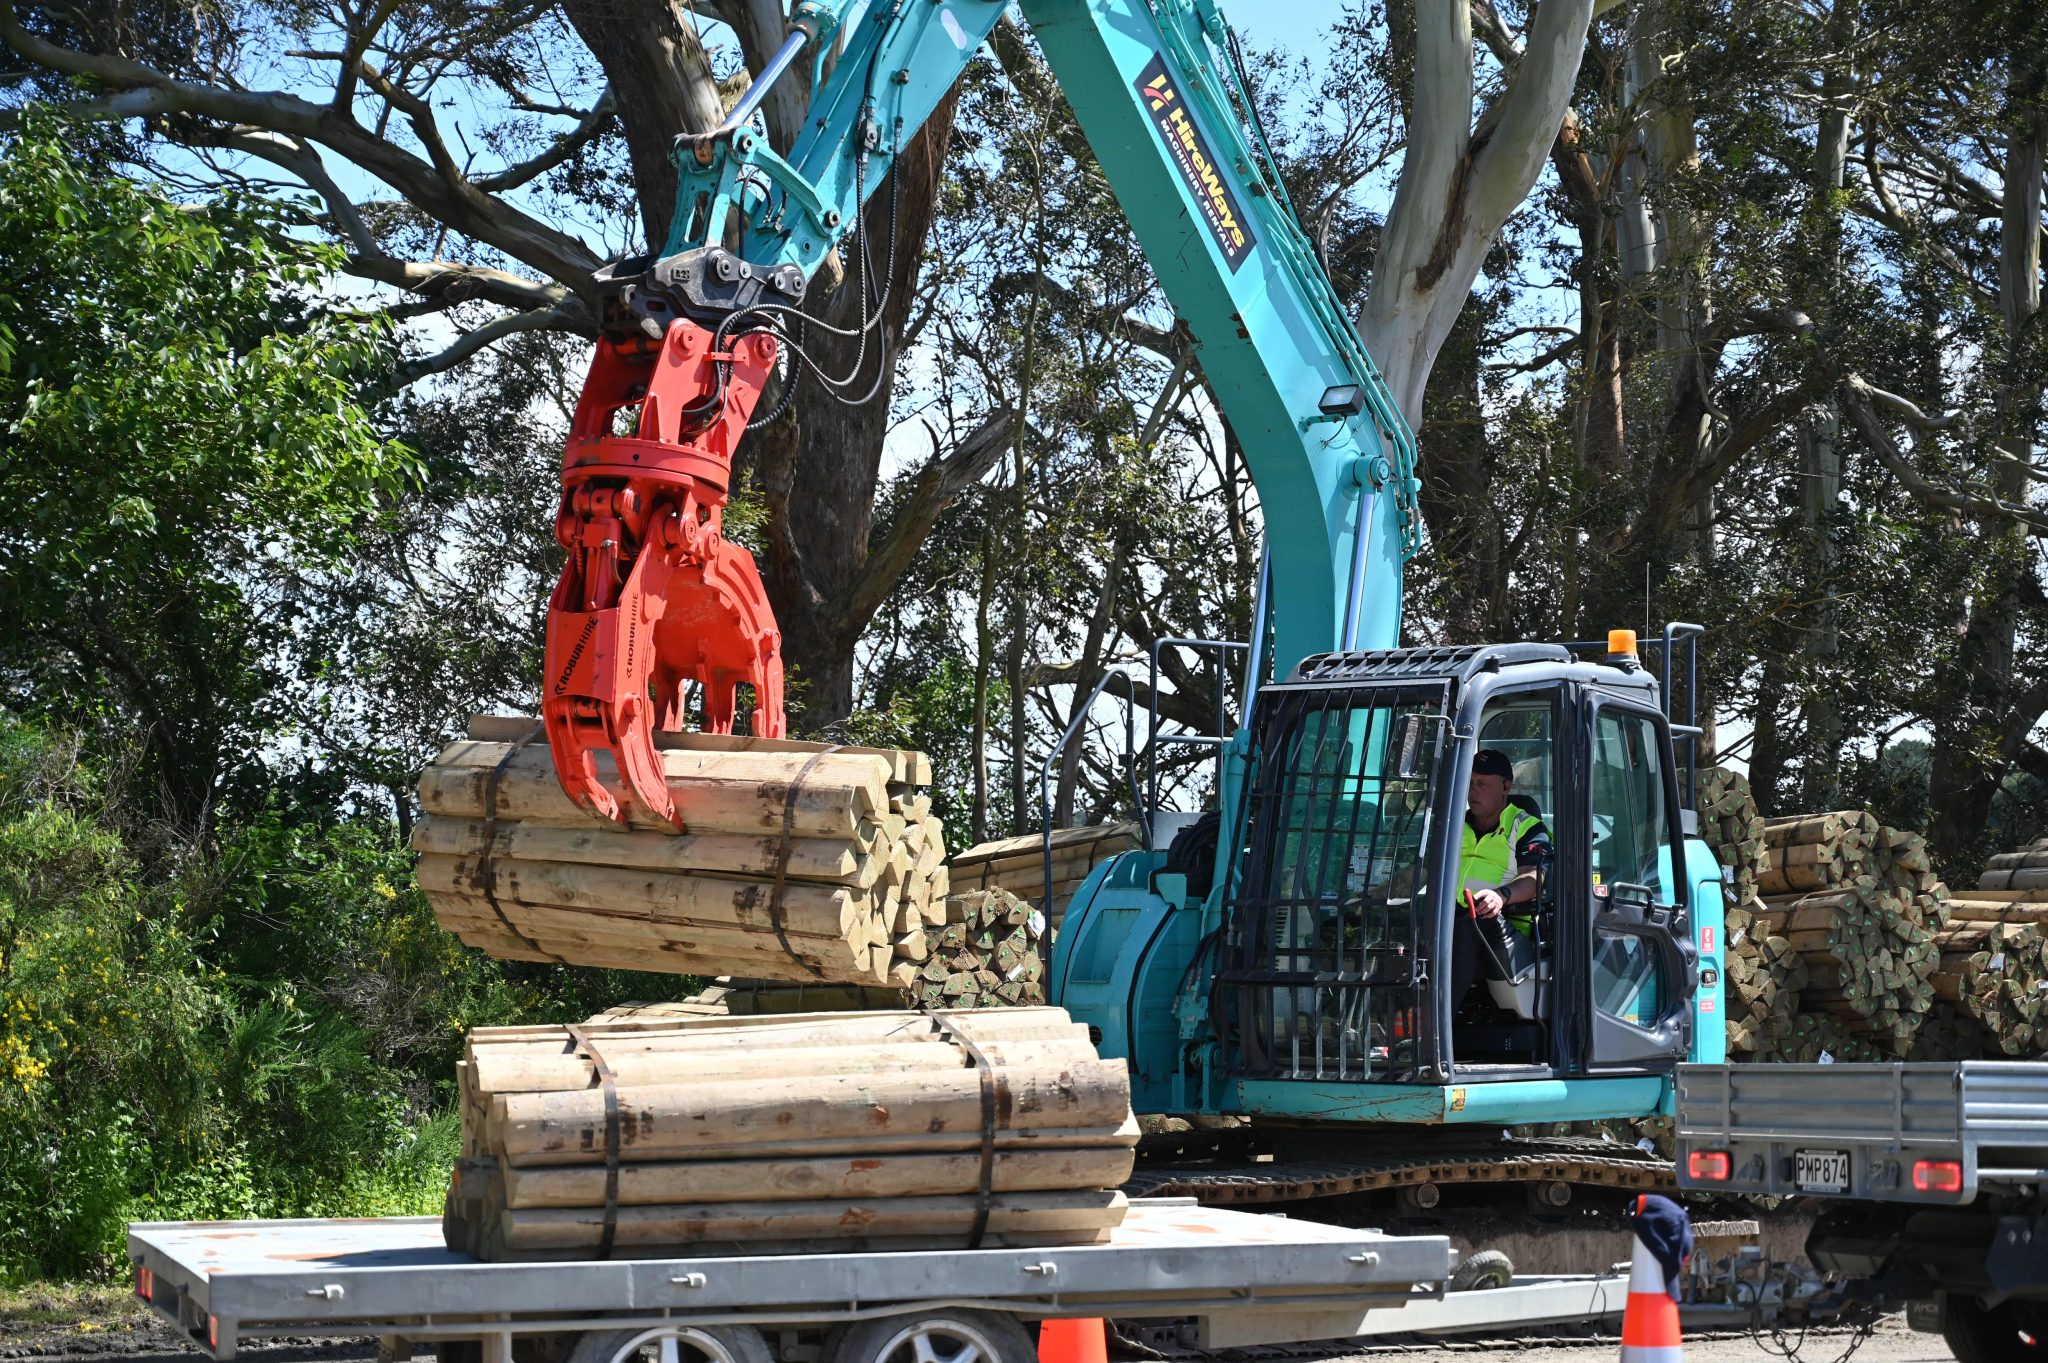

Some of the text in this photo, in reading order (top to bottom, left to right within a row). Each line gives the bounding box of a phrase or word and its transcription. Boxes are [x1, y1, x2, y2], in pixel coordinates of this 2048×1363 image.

[1160, 119, 1235, 257] MACHINERY RENTALS
[1169, 106, 1245, 248] HireWays
[1797, 1157, 1847, 1184] PMP874
